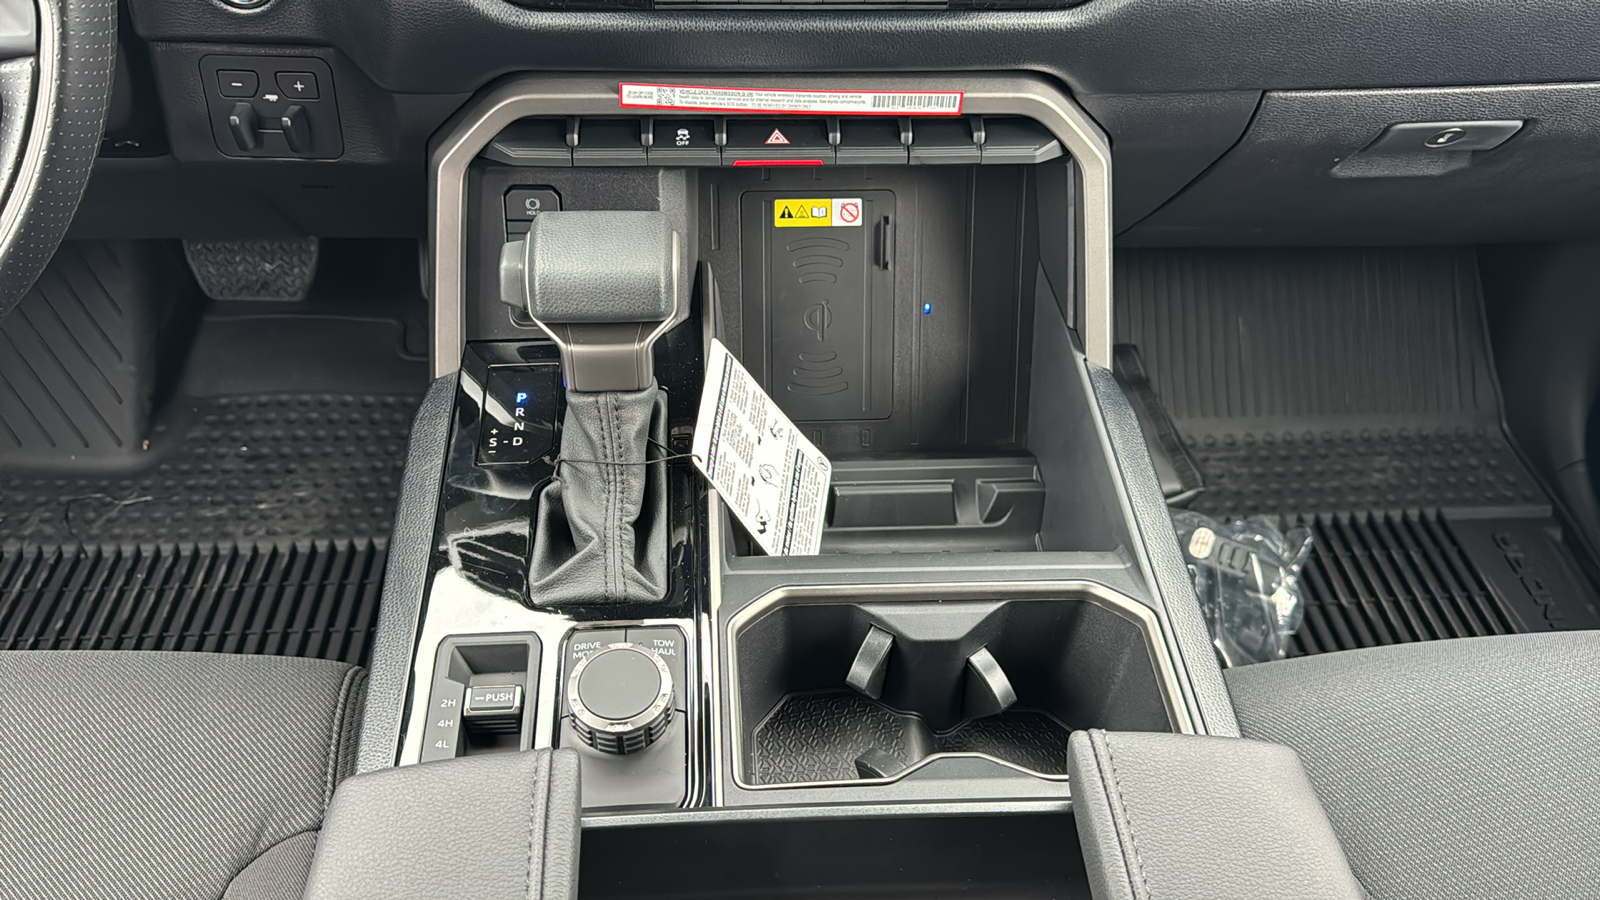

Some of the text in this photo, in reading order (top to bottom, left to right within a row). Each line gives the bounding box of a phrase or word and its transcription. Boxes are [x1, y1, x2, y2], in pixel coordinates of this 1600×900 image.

[516, 392, 527, 403] P
[515, 408, 525, 417] R
[514, 422, 524, 431] N
[489, 437, 523, 447] S D
[573, 641, 601, 651] DRIVE
[485, 693, 513, 702] PUSH
[440, 699, 456, 708] 2H
[437, 719, 454, 728] 4H
[435, 740, 450, 749] 4L
